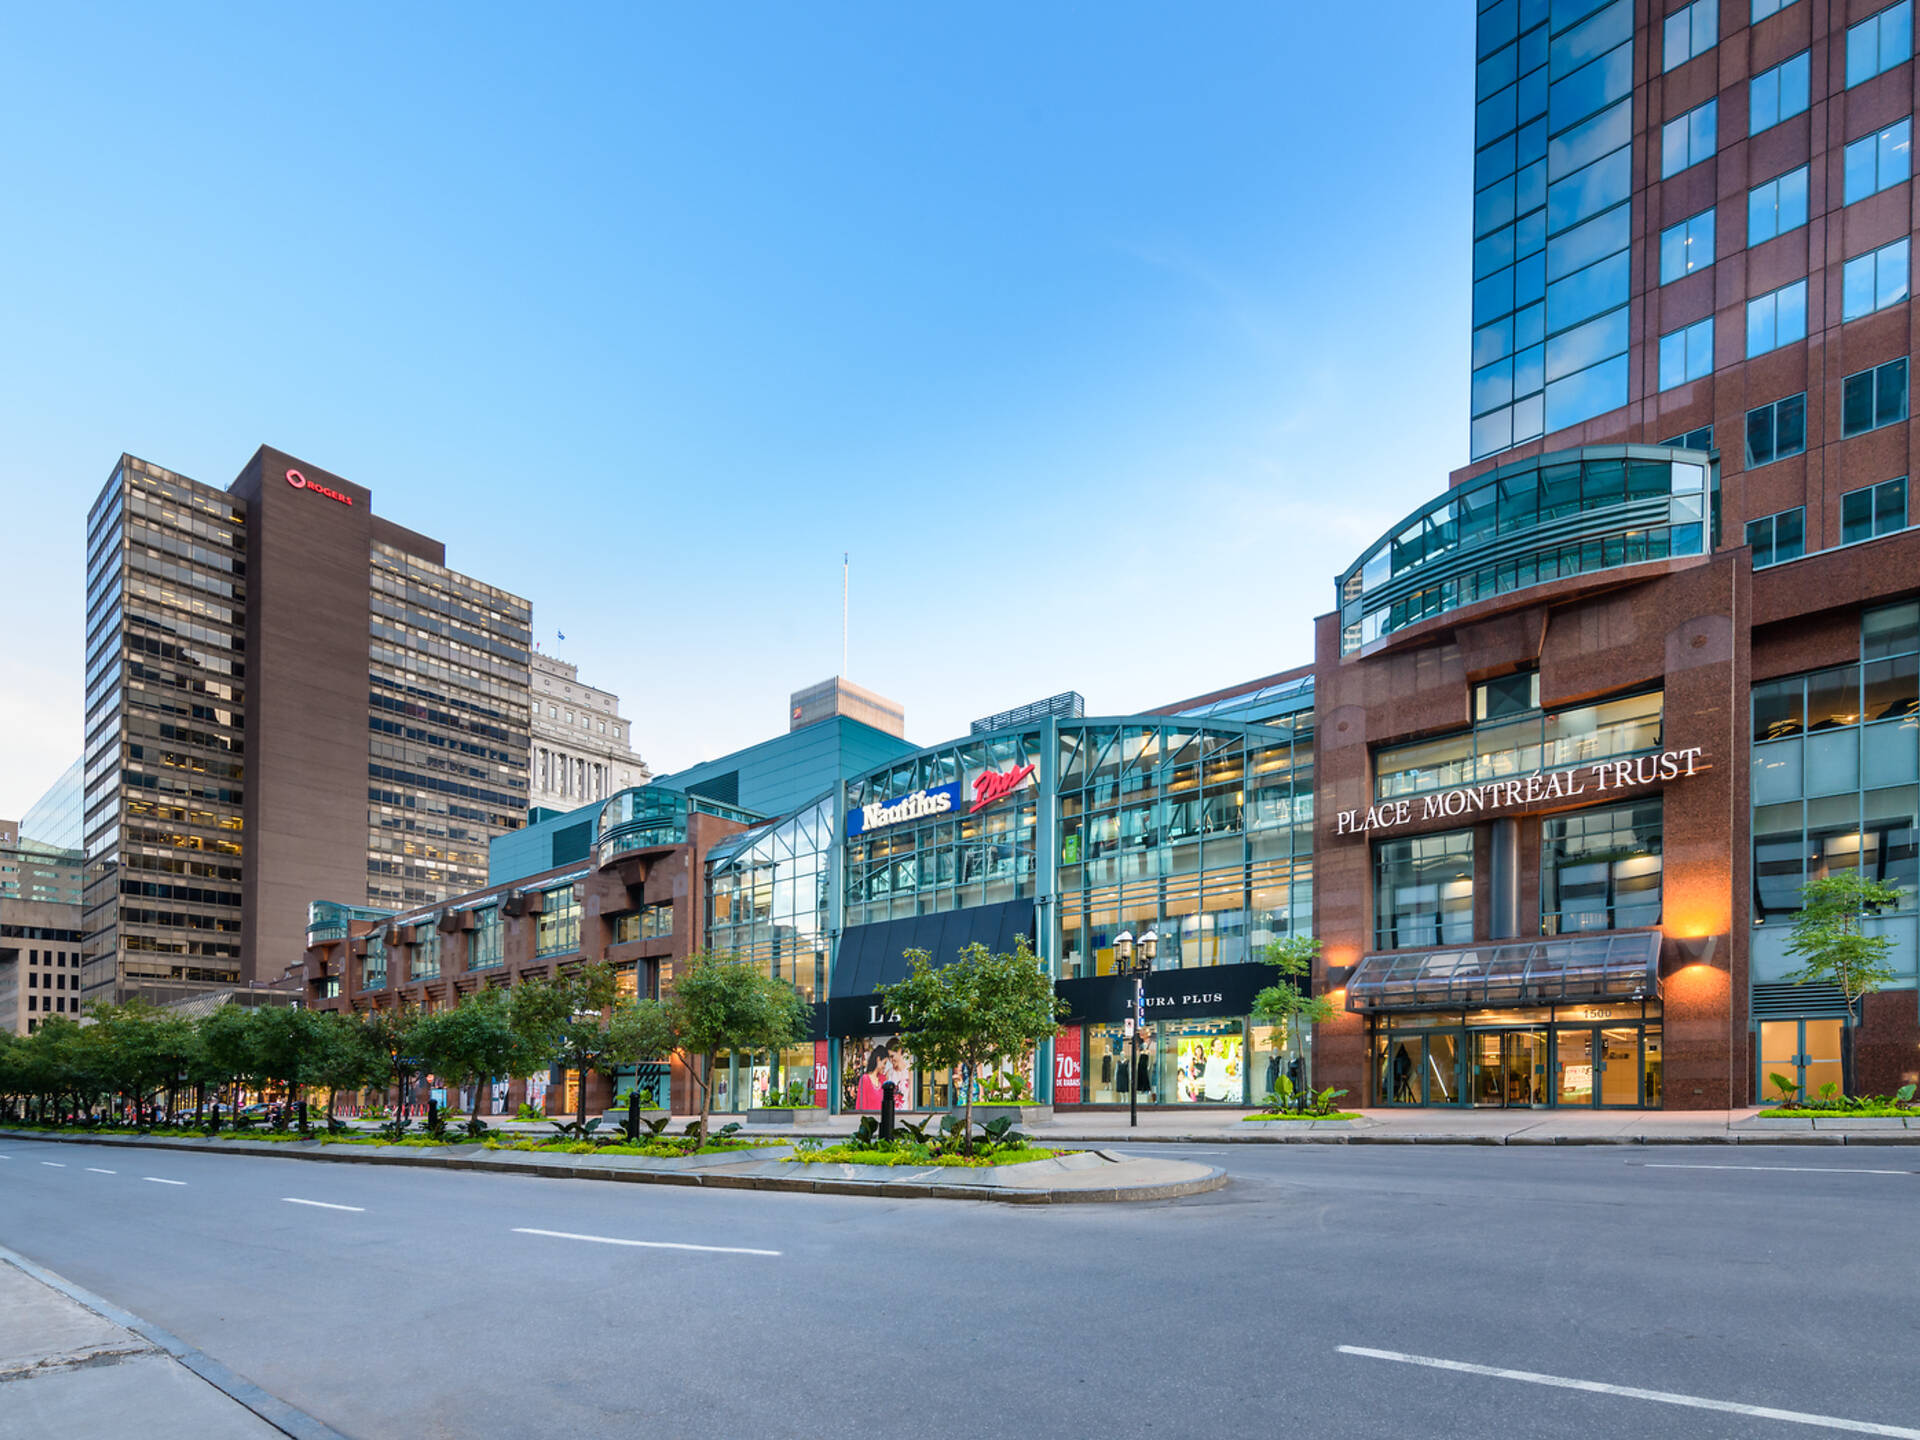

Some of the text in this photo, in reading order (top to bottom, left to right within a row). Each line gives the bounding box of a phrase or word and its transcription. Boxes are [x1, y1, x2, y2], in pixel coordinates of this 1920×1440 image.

[307, 480, 352, 506] ROGERS
[862, 764, 1035, 831] Nautilus Plus
[1335, 747, 1701, 835] PLACE MONTRÉAL TRUST
[1182, 993, 1223, 1005] PLUS
[1584, 1009, 1612, 1018] 1500
